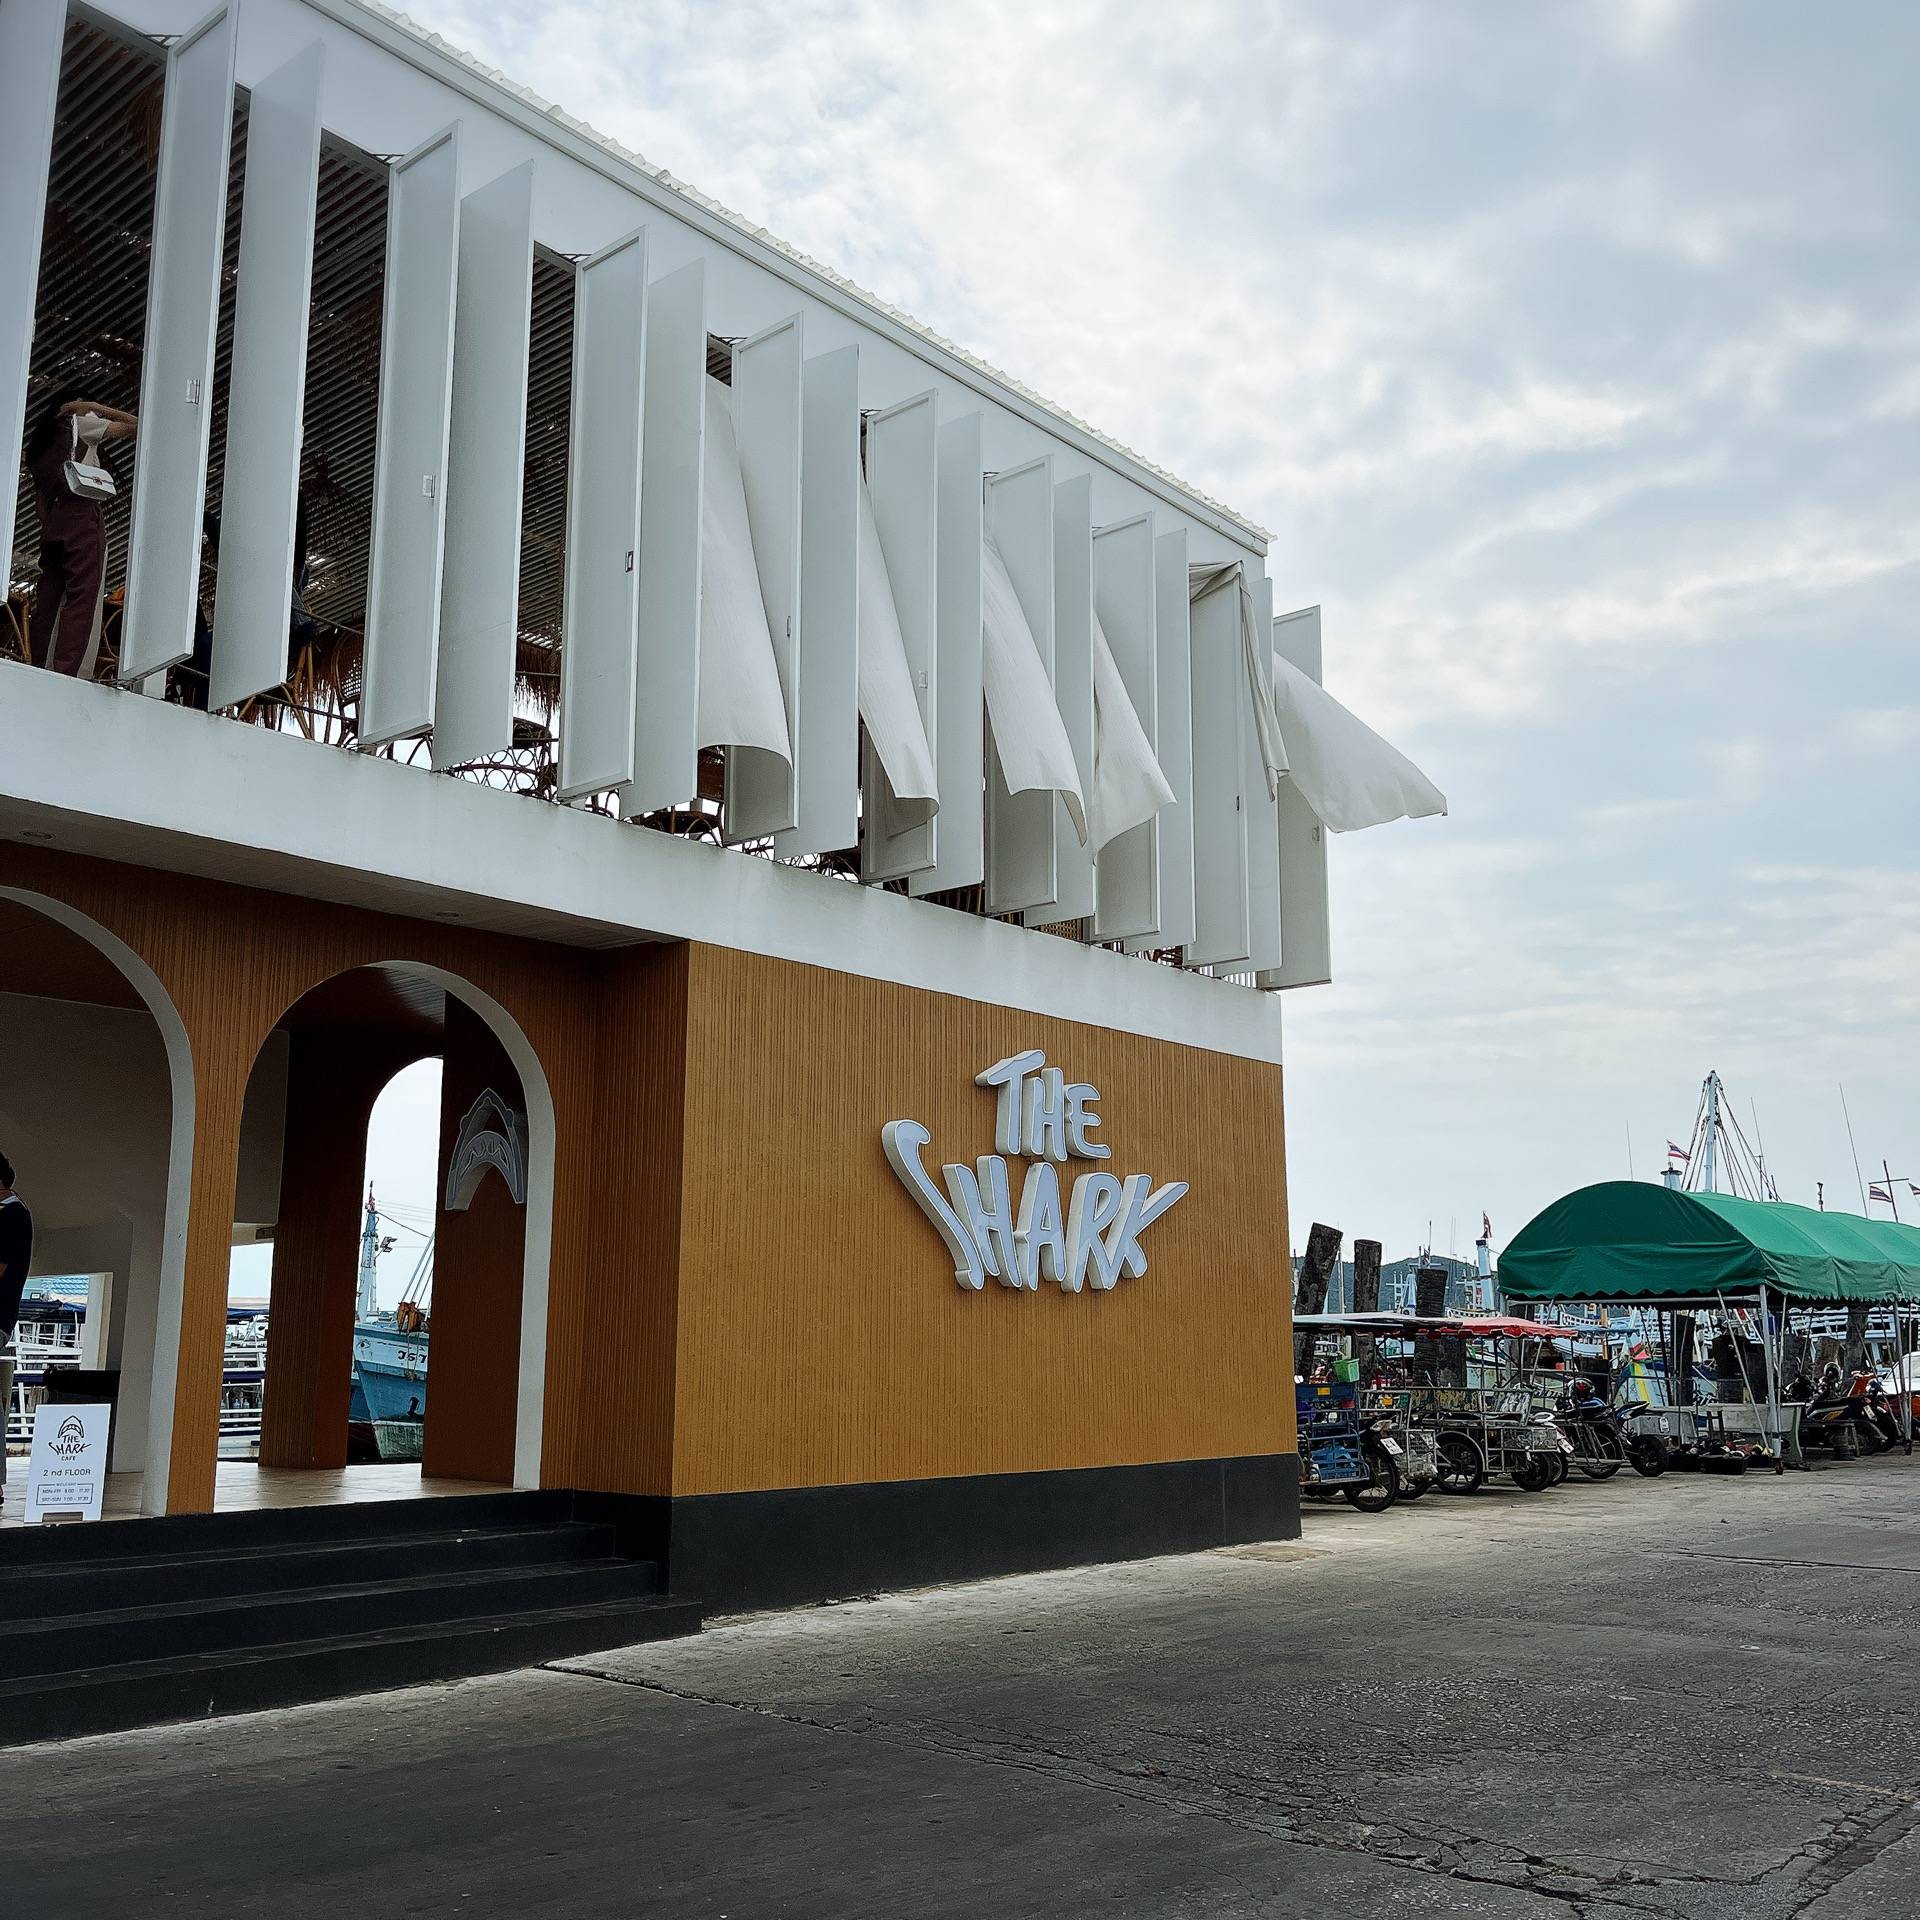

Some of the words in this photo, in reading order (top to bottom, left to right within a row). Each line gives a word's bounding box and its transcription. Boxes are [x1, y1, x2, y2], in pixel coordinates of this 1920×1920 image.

[975, 1049, 1111, 1162] THE
[881, 1119, 1190, 1293] SHARK
[62, 1434, 80, 1443] THE
[48, 1441, 92, 1455] SHARK
[64, 1468, 91, 1476] FLOOR
